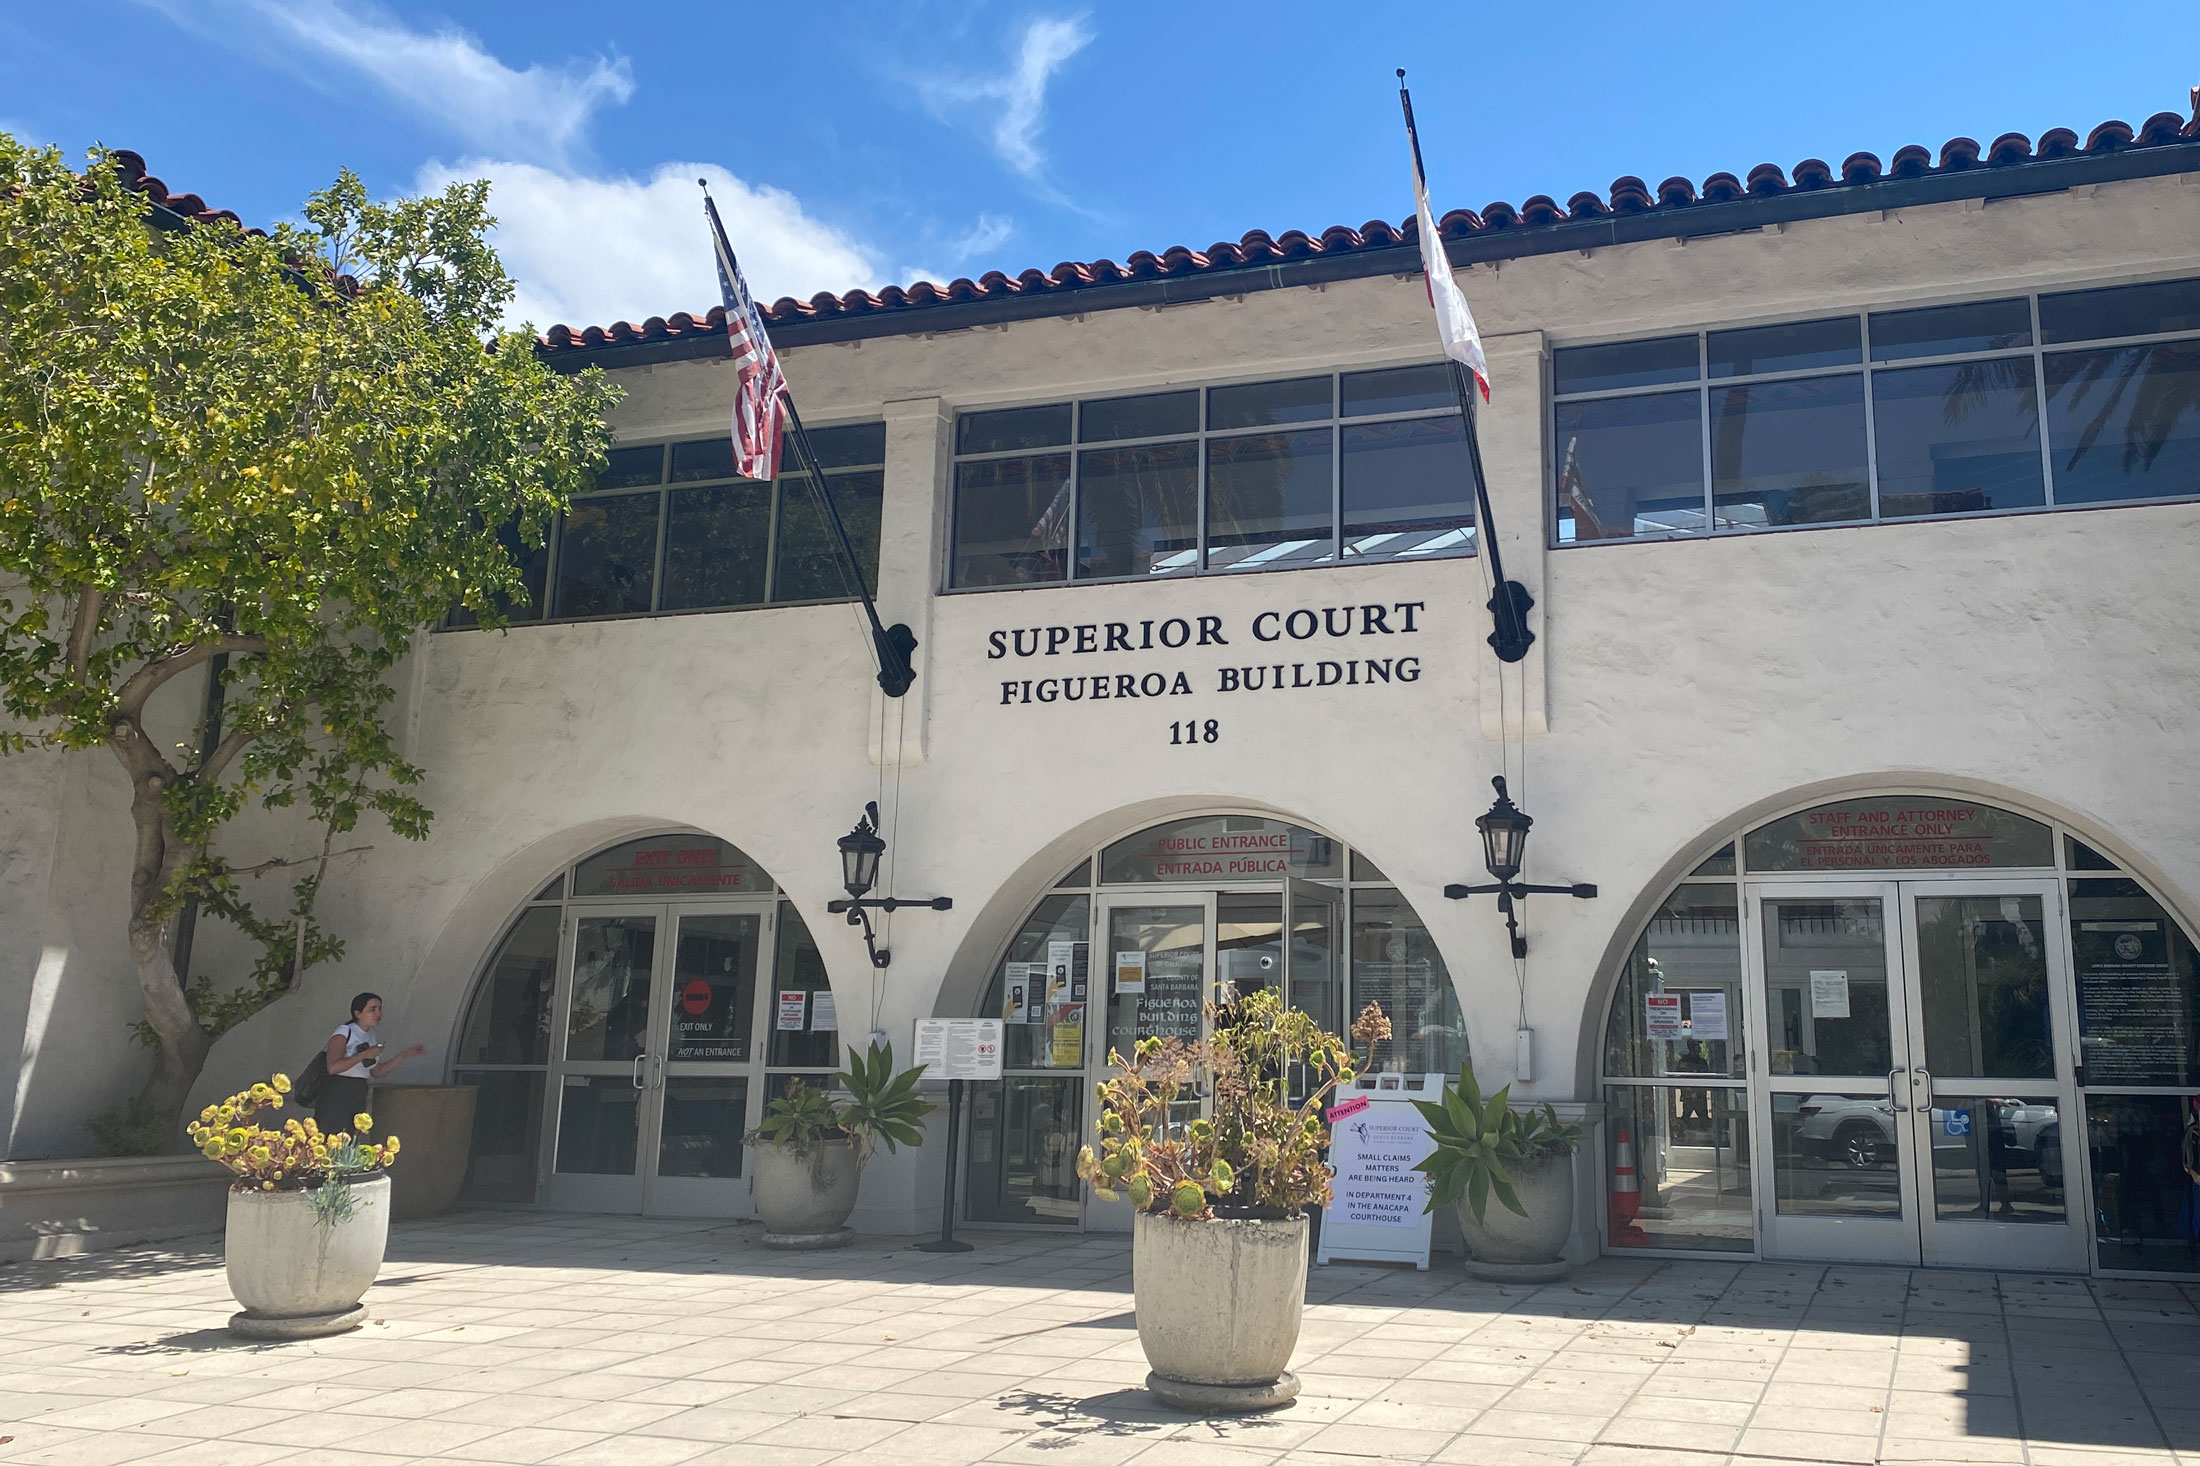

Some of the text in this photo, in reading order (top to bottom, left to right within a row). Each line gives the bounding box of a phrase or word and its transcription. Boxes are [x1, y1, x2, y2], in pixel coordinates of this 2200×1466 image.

[987, 602, 1425, 660] SUPERIOR COURT
[1000, 657, 1421, 705] FIGUEROA BUILDING
[1169, 719, 1219, 745] 118
[1809, 809, 1976, 824] STAFF AND ATTORNEY
[1831, 823, 1954, 837] ENTRANCE ONLY
[1157, 834, 1287, 850] PUBLIC ENTRANCE
[1806, 846, 1862, 856] ENTRADA
[1950, 843, 1984, 854] PARA
[634, 848, 718, 865] EXIT ONLY
[1801, 854, 1991, 867] EL PERSONAL Y LOS ABOGADOS
[1157, 856, 1287, 875] ENTRADA PÚBLICA
[680, 1022, 713, 1031] EXIT ONLY
[678, 1047, 742, 1057] NOT AN ENTRANCE
[1329, 1100, 1367, 1119] ATTENTION
[1357, 1153, 1411, 1162] SMALL CLAIMS
[1364, 1175, 1387, 1183] BEING
[1356, 1192, 1406, 1201] DEPARTMENT
[1372, 1204, 1409, 1212] ANACAPA
[1350, 1213, 1402, 1223] COURTHOUSE
